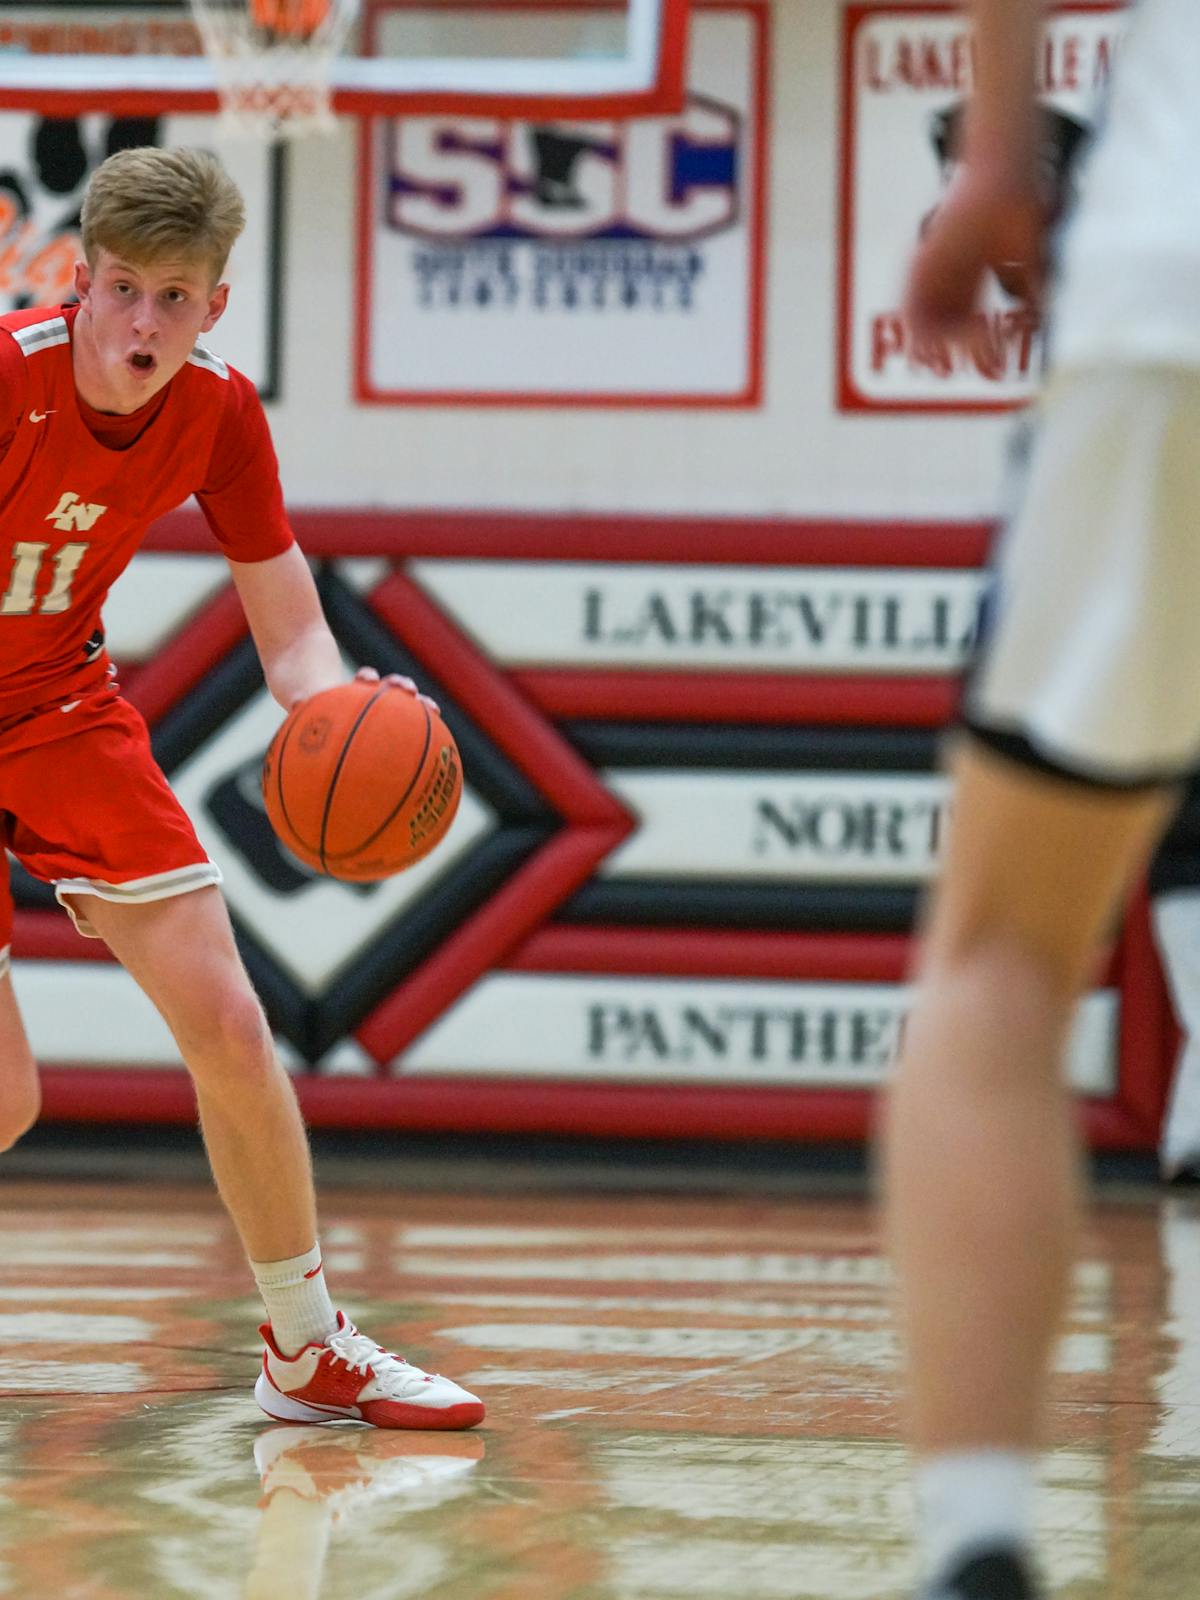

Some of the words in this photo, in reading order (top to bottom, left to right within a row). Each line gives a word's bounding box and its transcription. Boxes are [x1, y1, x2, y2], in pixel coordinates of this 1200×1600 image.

[398, 108, 734, 237] SSC
[579, 588, 974, 650] LAKEVILL
[754, 797, 946, 857] NORT
[586, 1003, 906, 1066] PANTHE
